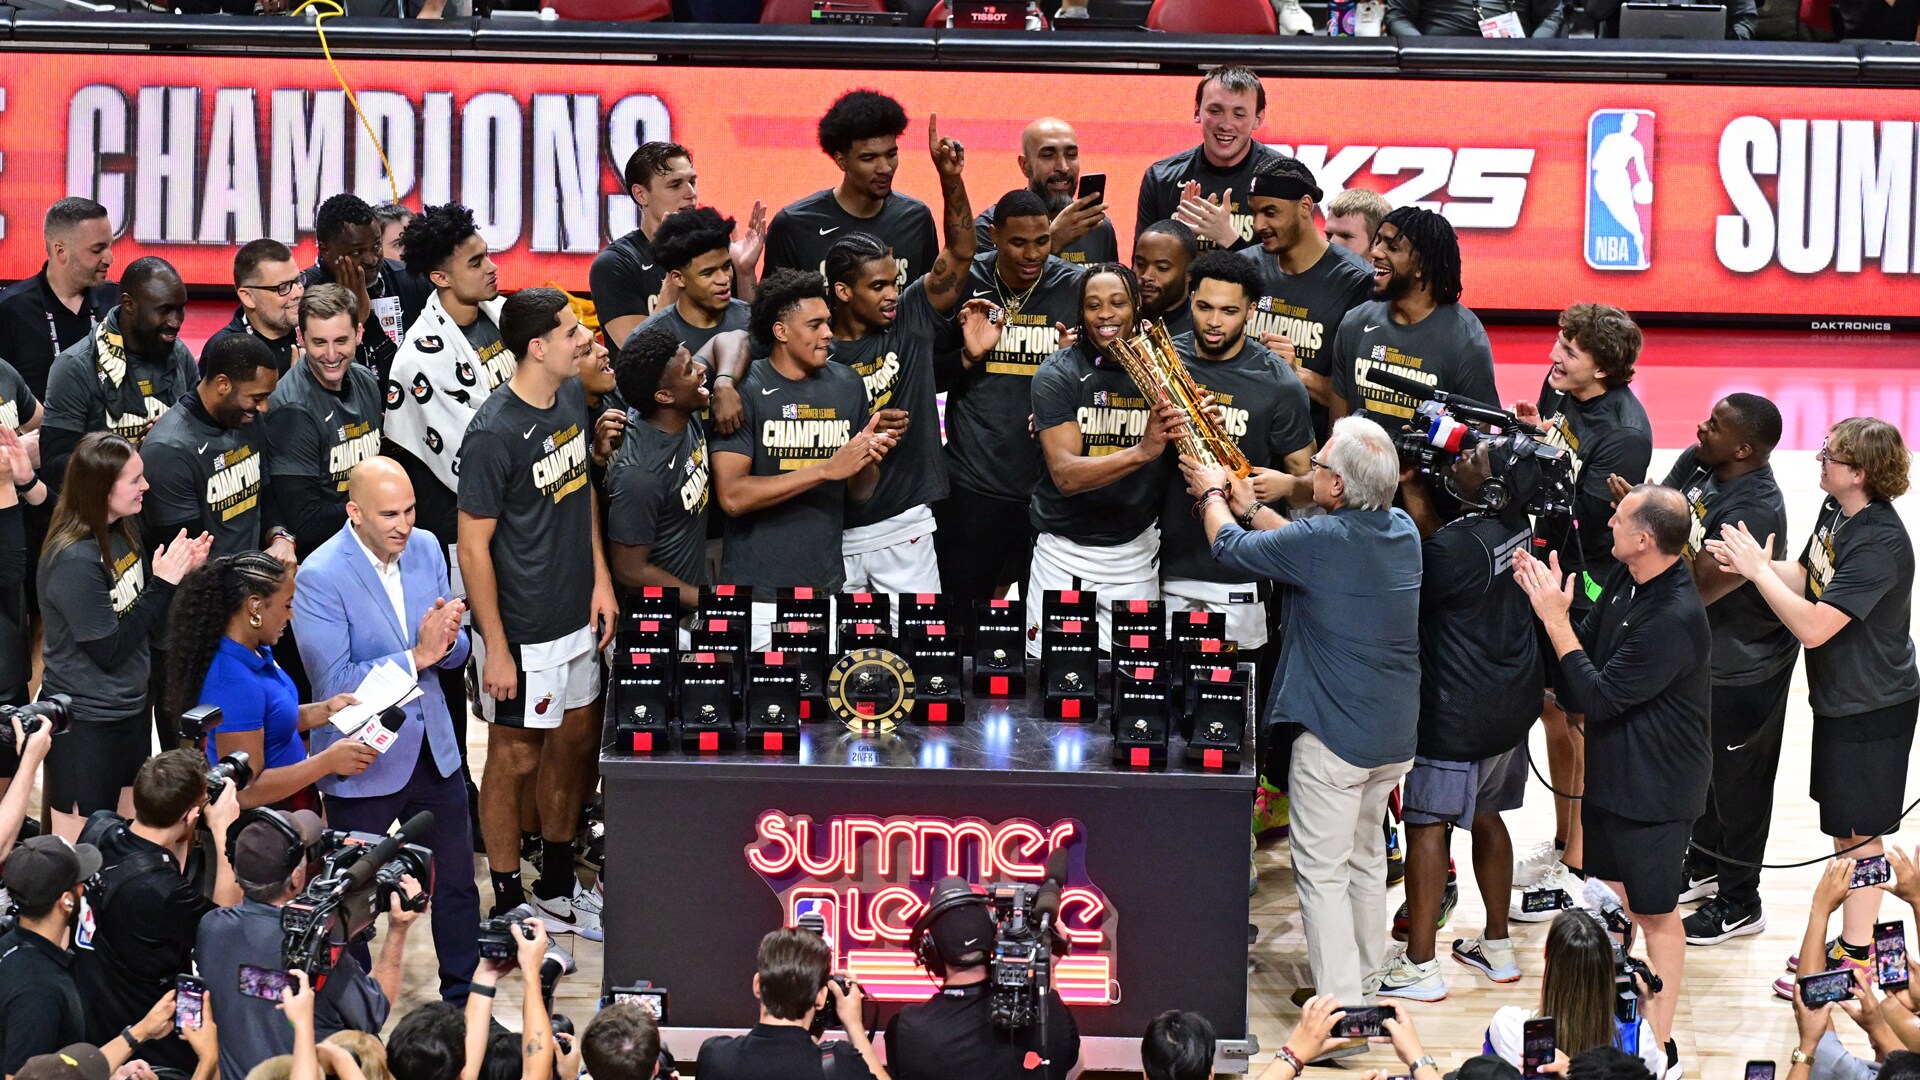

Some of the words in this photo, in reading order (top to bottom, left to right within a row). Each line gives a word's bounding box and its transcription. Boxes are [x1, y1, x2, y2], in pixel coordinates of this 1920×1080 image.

[971, 13, 1008, 22] TISSOT
[1263, 144, 1535, 229] K25
[1715, 114, 1920, 274] SUM
[1594, 236, 1630, 262] NBA
[1244, 310, 1324, 350] HAMPIONS
[1811, 321, 1891, 331] DAKTRONICS
[1297, 349, 1316, 359] EGAS
[798, 408, 818, 418] SUMMER
[819, 408, 836, 418] LEAGUE
[1077, 406, 1151, 436] CHAMPION
[762, 420, 850, 448] CHAMPIONS
[532, 428, 586, 489] CHAMPION
[206, 450, 261, 504] CHAMPION
